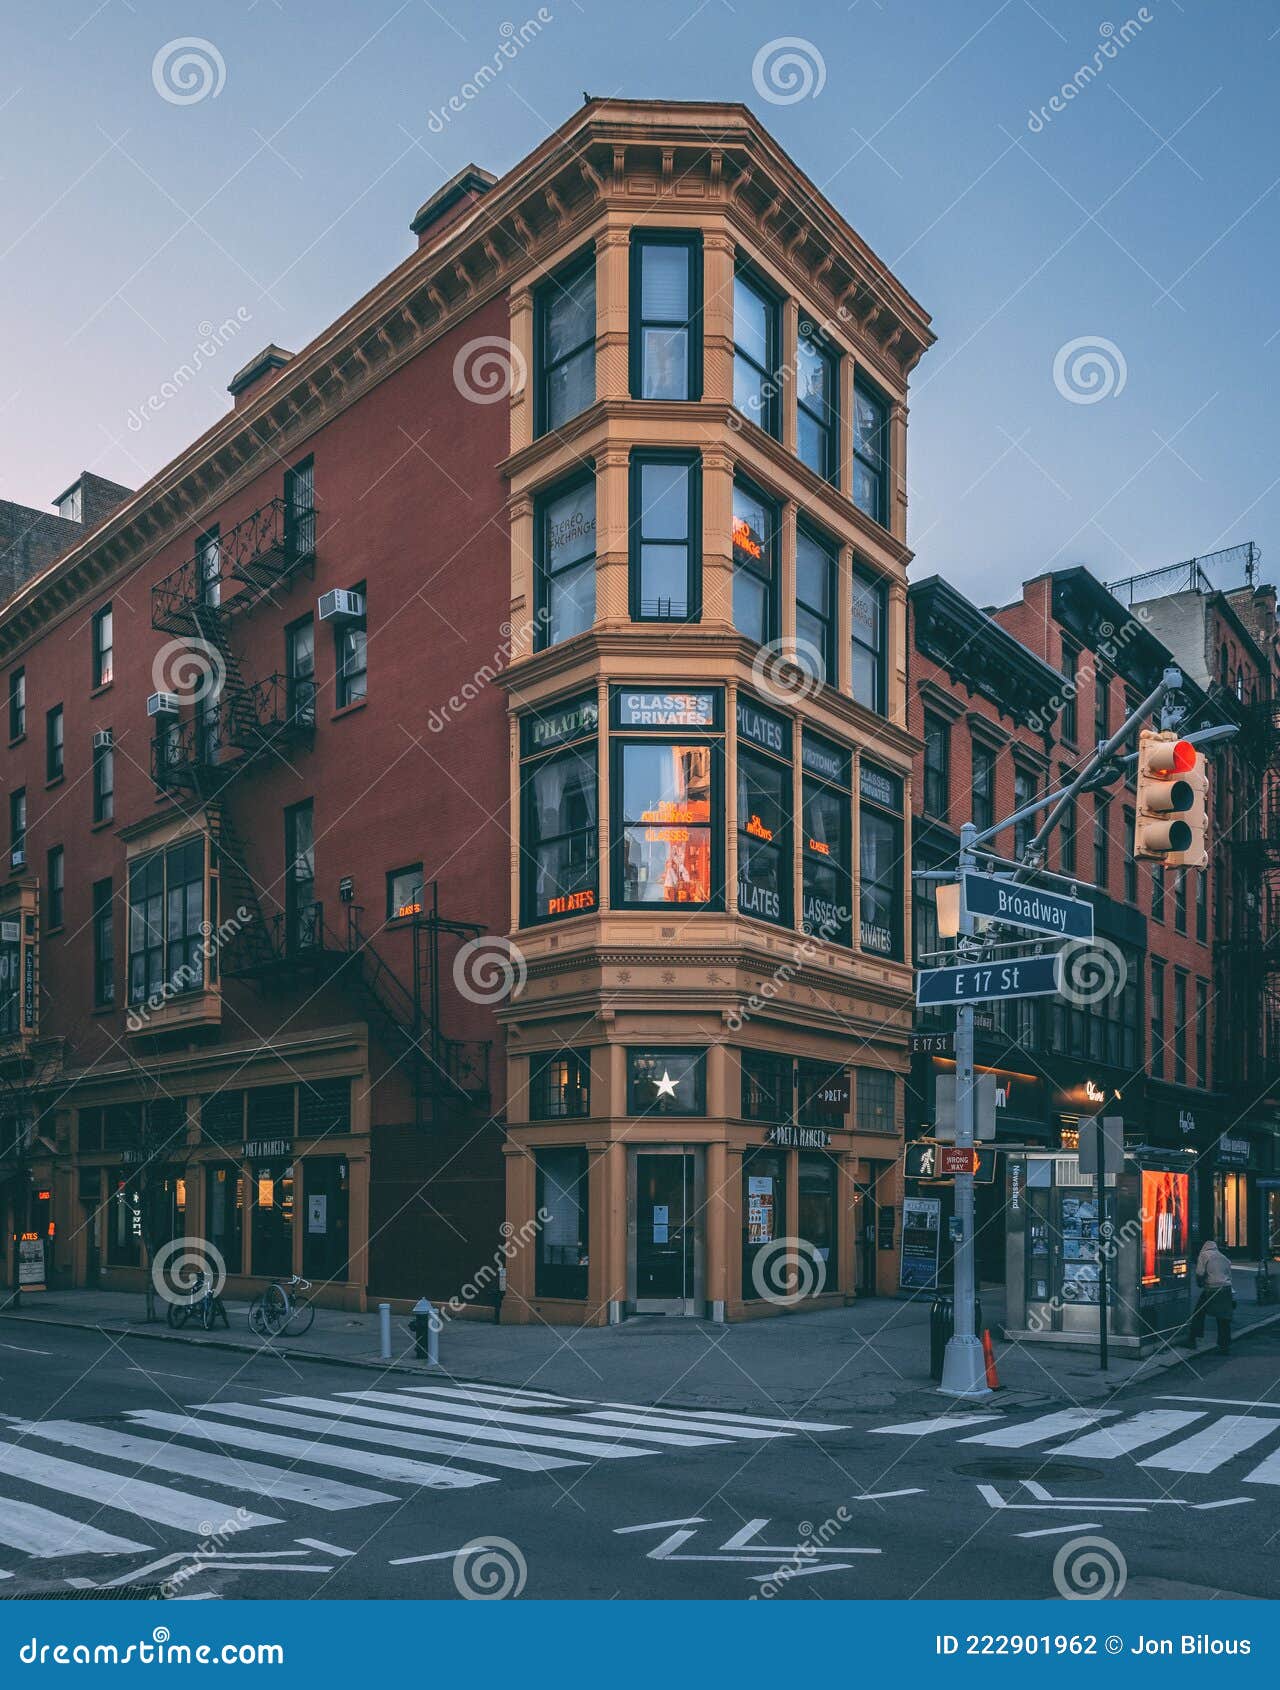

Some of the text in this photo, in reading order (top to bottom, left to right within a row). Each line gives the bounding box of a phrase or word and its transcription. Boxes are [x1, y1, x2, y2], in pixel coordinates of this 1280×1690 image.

[627, 695, 708, 711] CLASSES
[631, 711, 706, 724] PRIVATES
[548, 890, 594, 915] PILATES
[736, 881, 779, 918] ILATES
[803, 895, 838, 929] LASSES
[999, 890, 1067, 932] Broadway
[860, 921, 892, 953] RIVATES
[955, 967, 1020, 994] E 17 St
[913, 1037, 947, 1051] E 17 St
[824, 1089, 842, 1102] PRET
[946, 1156, 969, 1164] WRONG
[1012, 1165, 1020, 1209] Newsstand
[132, 1209, 141, 1236] PRET
